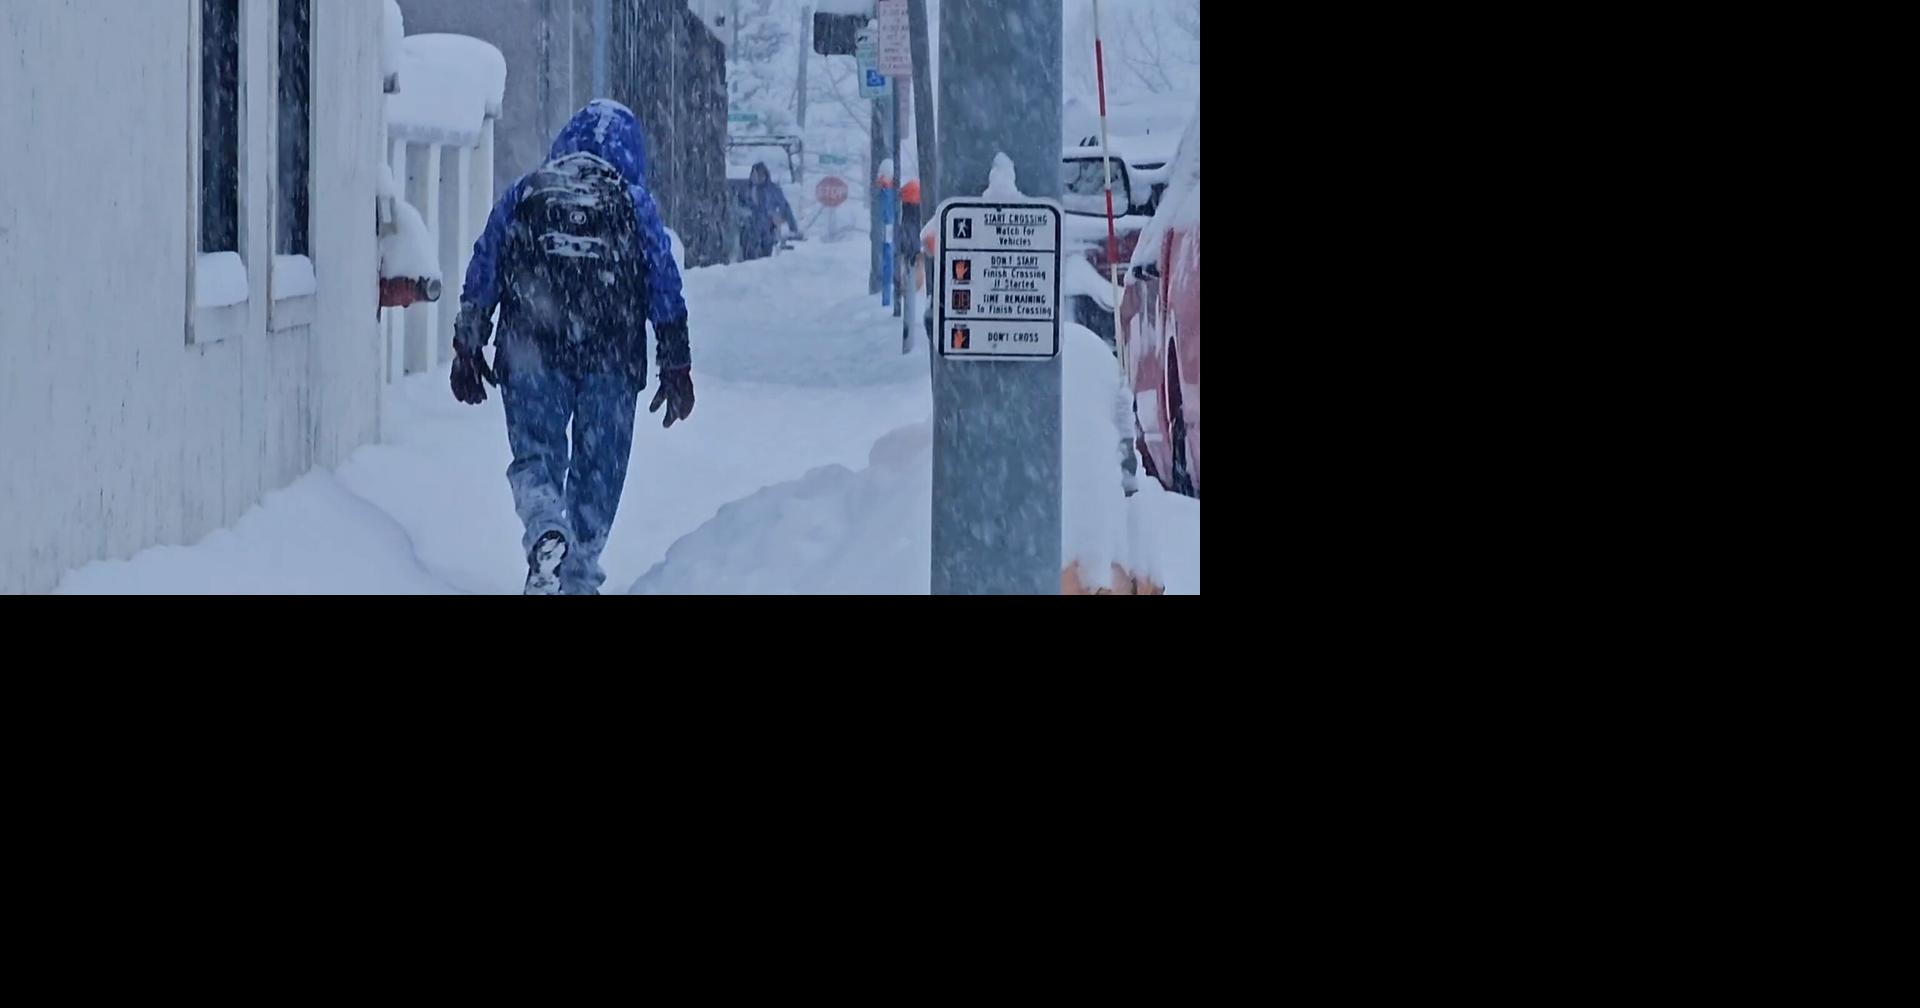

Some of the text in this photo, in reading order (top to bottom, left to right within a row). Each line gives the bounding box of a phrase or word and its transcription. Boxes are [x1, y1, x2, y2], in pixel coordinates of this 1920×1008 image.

[984, 214, 1048, 223] START CROSSING
[996, 226, 1019, 235] Watch
[999, 237, 1032, 246] Vehicles
[1017, 256, 1039, 266] START
[983, 268, 1046, 280] Finish Crossing
[994, 279, 1035, 289] If Started
[983, 294, 1046, 304] TIME REMAINING
[977, 304, 1052, 317] To Finish Crossing
[988, 332, 1039, 343] DON'T CROSS
